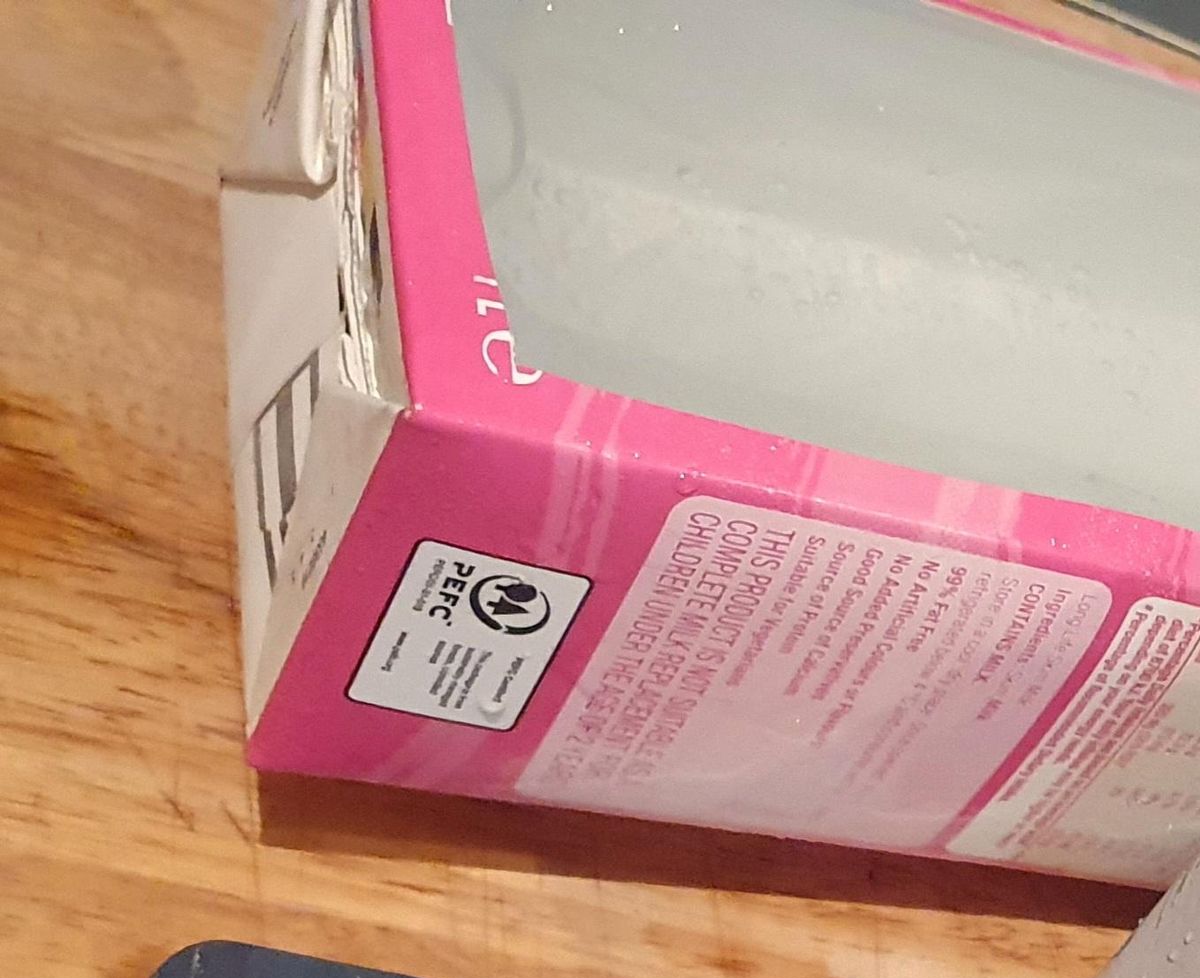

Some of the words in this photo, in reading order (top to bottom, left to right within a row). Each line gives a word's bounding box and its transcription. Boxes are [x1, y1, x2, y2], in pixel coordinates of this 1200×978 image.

[651, 511, 723, 599] CHILDREN
[685, 518, 761, 611] COMPLETE
[747, 526, 797, 570] THIS
[779, 534, 827, 594] Suitable
[813, 541, 856, 592] Source
[849, 547, 885, 585] Good
[887, 553, 913, 574] No
[915, 559, 941, 580] No
[425, 561, 476, 621] PEFC
[861, 577, 900, 620] Added
[936, 565, 970, 599] 99%
[620, 598, 677, 654] UNDER
[705, 570, 774, 647] PRODUCT
[768, 596, 795, 616] for
[822, 587, 864, 632] Source
[881, 582, 929, 641] Artificial
[923, 601, 950, 623] Fat
[992, 582, 1047, 652] CONTAINS
[661, 611, 710, 652] MILK
[723, 617, 781, 688] Vegetarians
[777, 609, 817, 655] Protein
[904, 625, 935, 653] Free
[601, 653, 646, 685] THE
[674, 663, 719, 695] NOT
[782, 648, 827, 697] Calcium
[850, 641, 893, 686] Colours
[973, 653, 1006, 684] MILK
